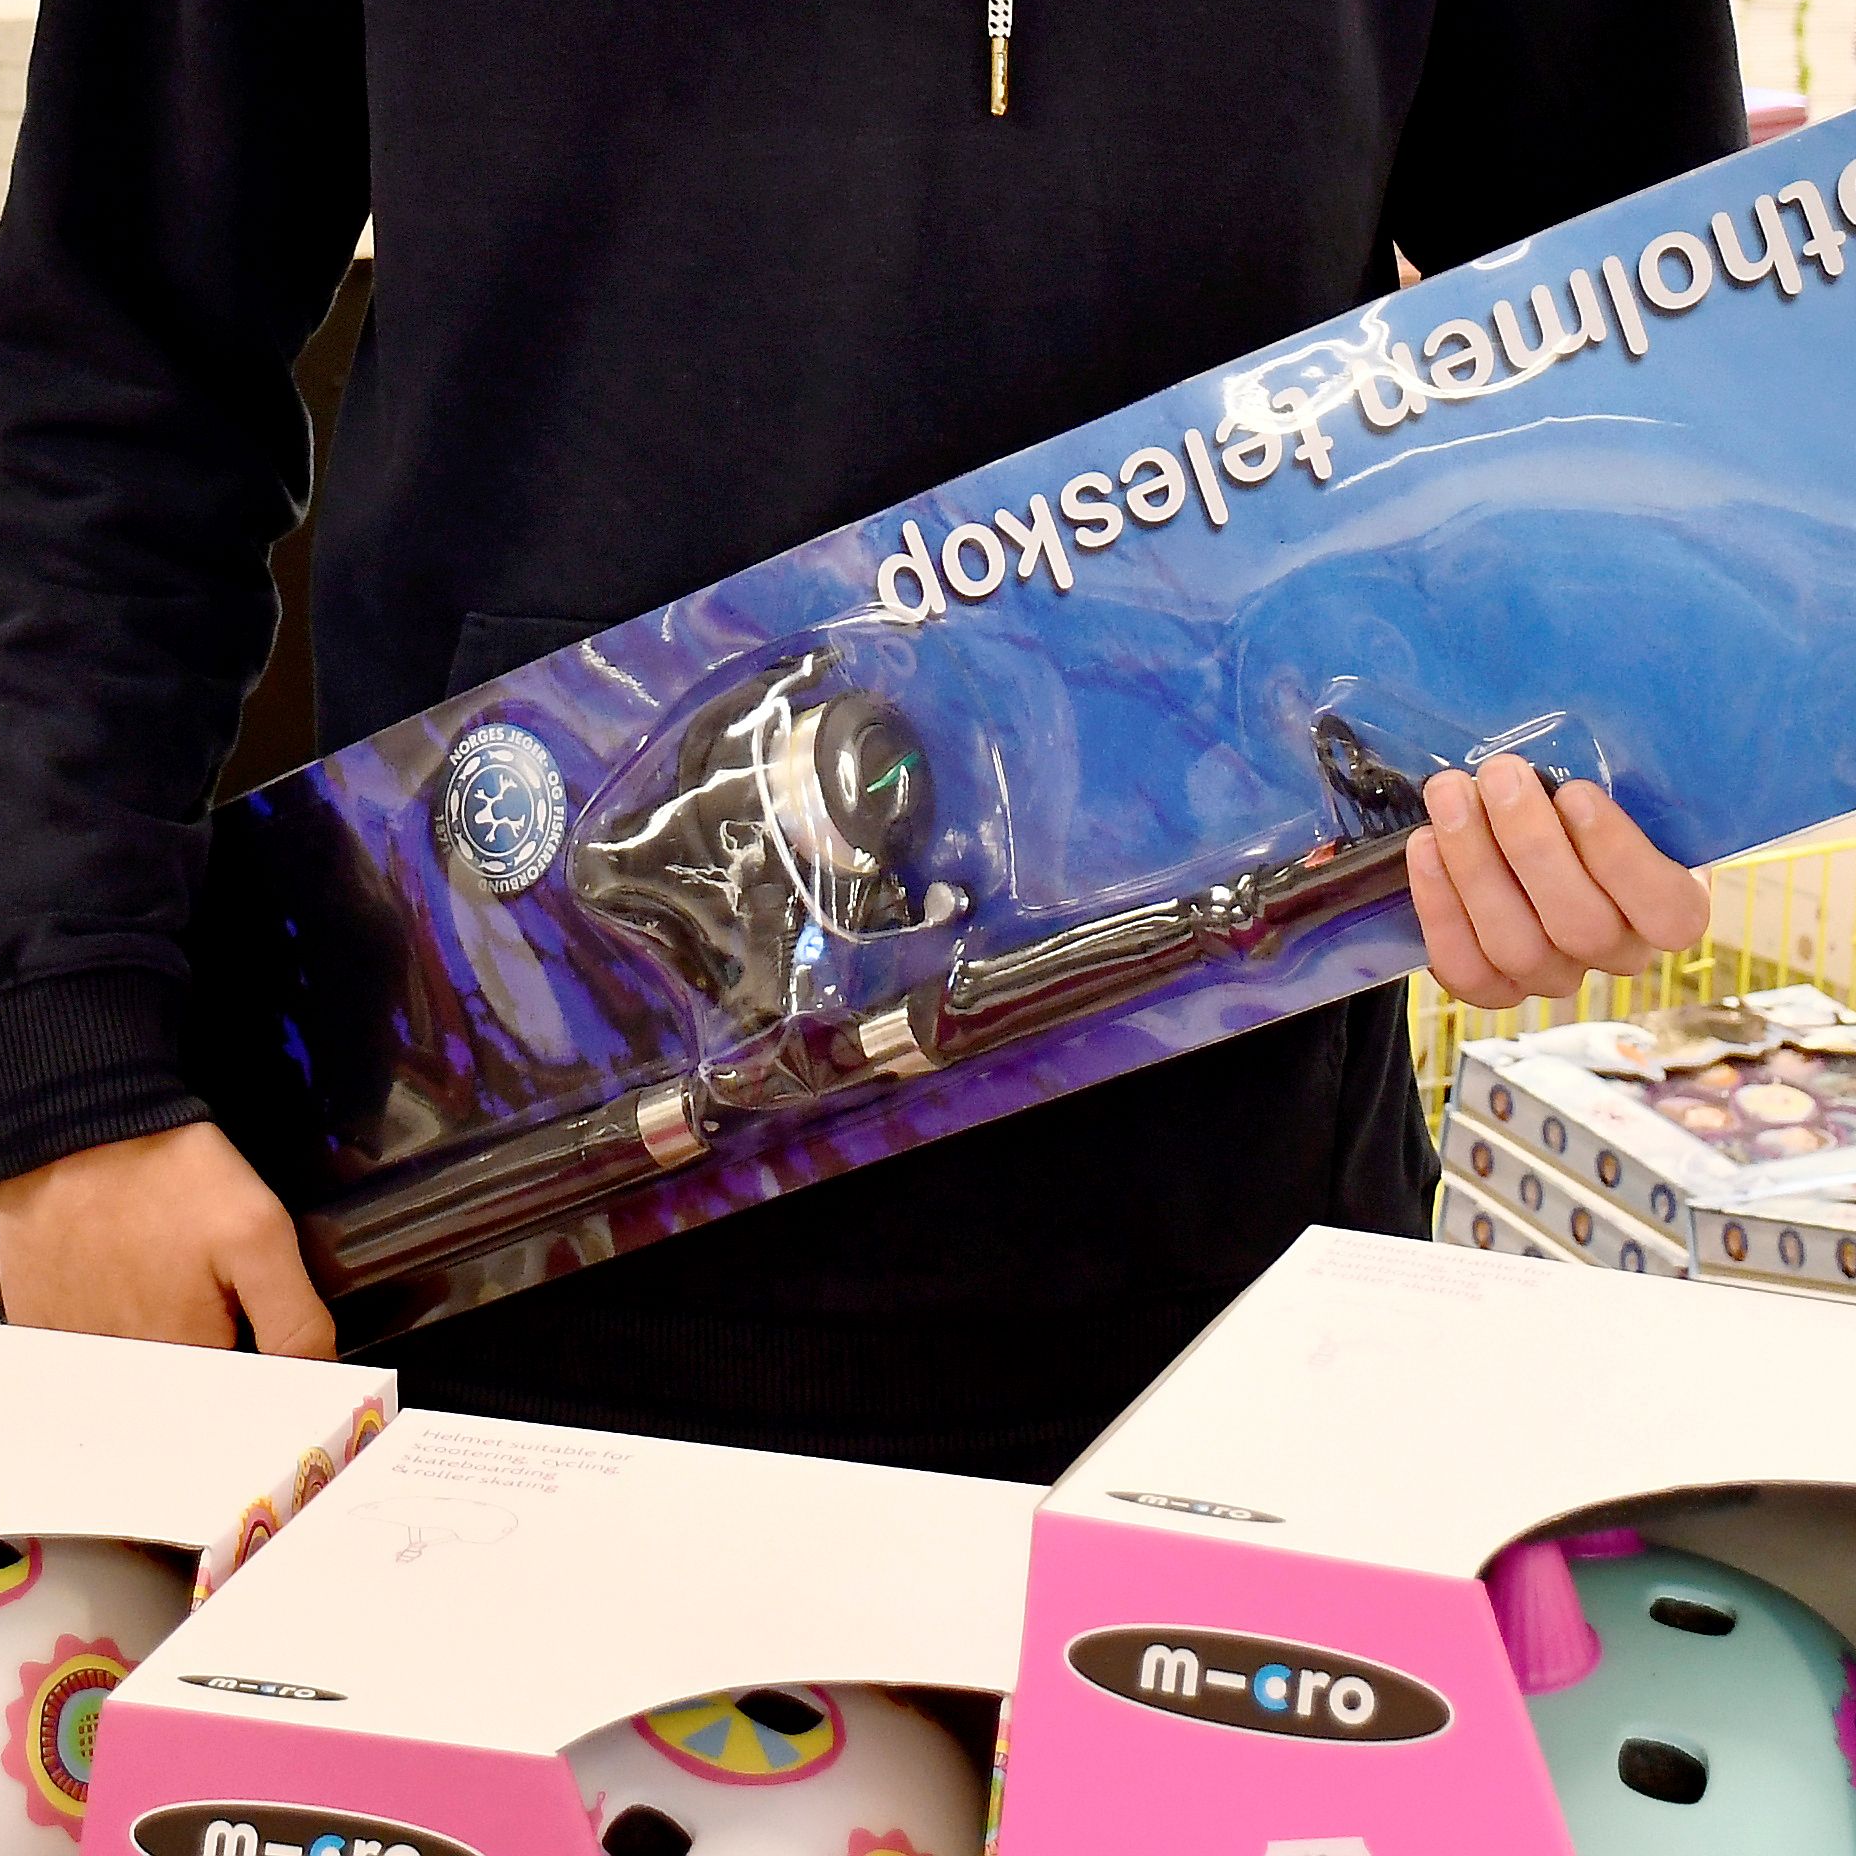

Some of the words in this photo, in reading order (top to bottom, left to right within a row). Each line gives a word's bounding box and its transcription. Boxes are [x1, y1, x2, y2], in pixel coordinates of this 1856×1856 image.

[873, 389, 1337, 630] teleskop
[448, 726, 505, 766] NORGES
[546, 770, 563, 801] OG
